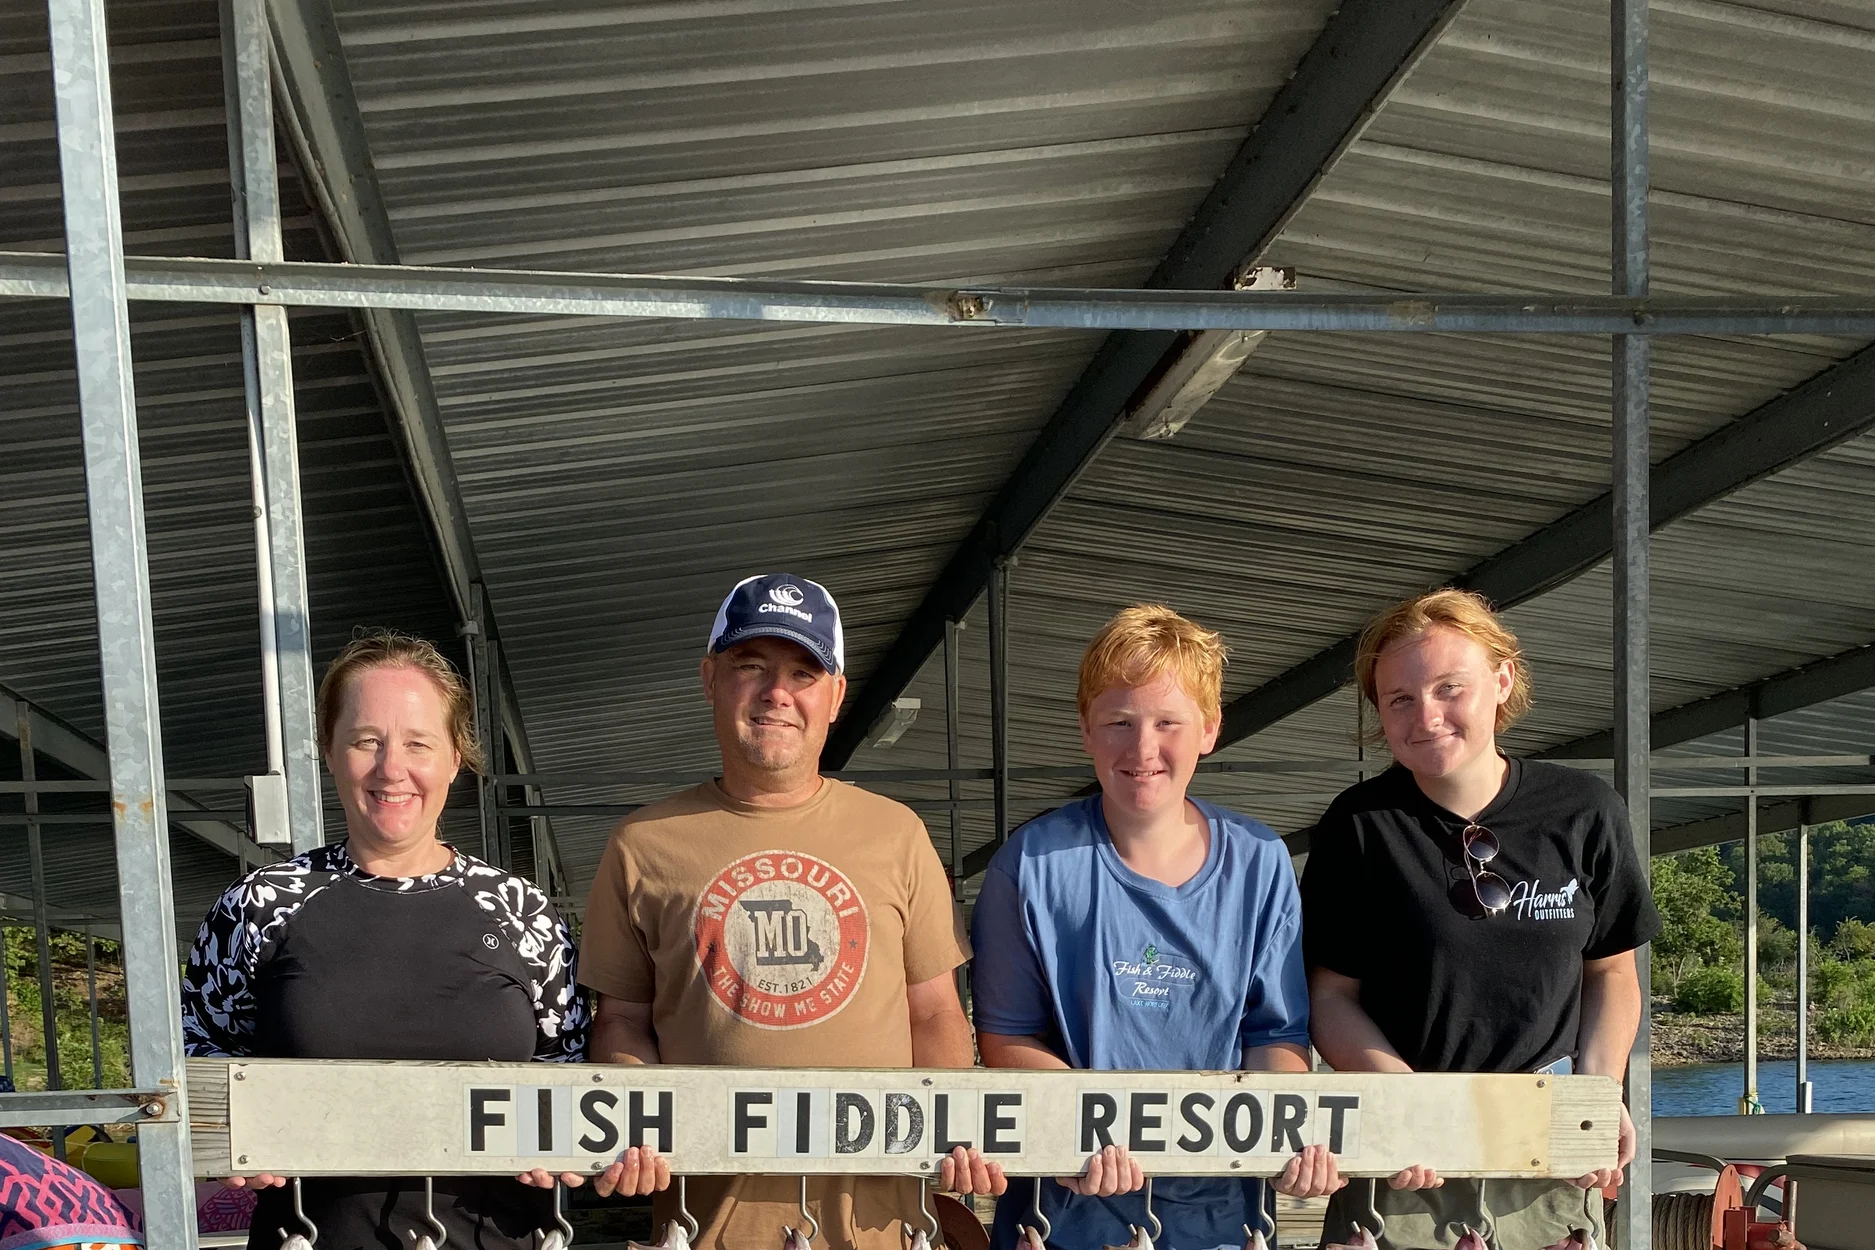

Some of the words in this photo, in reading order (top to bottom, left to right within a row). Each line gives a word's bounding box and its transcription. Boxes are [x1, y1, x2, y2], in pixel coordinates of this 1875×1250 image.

[758, 603, 813, 623] Channel
[701, 857, 859, 921] MISSOURI
[1511, 879, 1567, 921] Harris
[754, 909, 808, 958] MO
[1534, 908, 1575, 921] OUTFITTERS
[712, 965, 740, 998] THE
[739, 993, 786, 1019] SHOW
[794, 997, 818, 1017] ME
[819, 961, 855, 1005] STATE
[1113, 960, 1141, 976] Fish
[1142, 966, 1153, 976] &
[1156, 964, 1196, 980] Fiddle
[1132, 981, 1170, 997] Resort
[469, 1088, 673, 1154] FISH
[734, 1091, 1022, 1154] FIDDLE
[1080, 1091, 1359, 1156] RESORT
